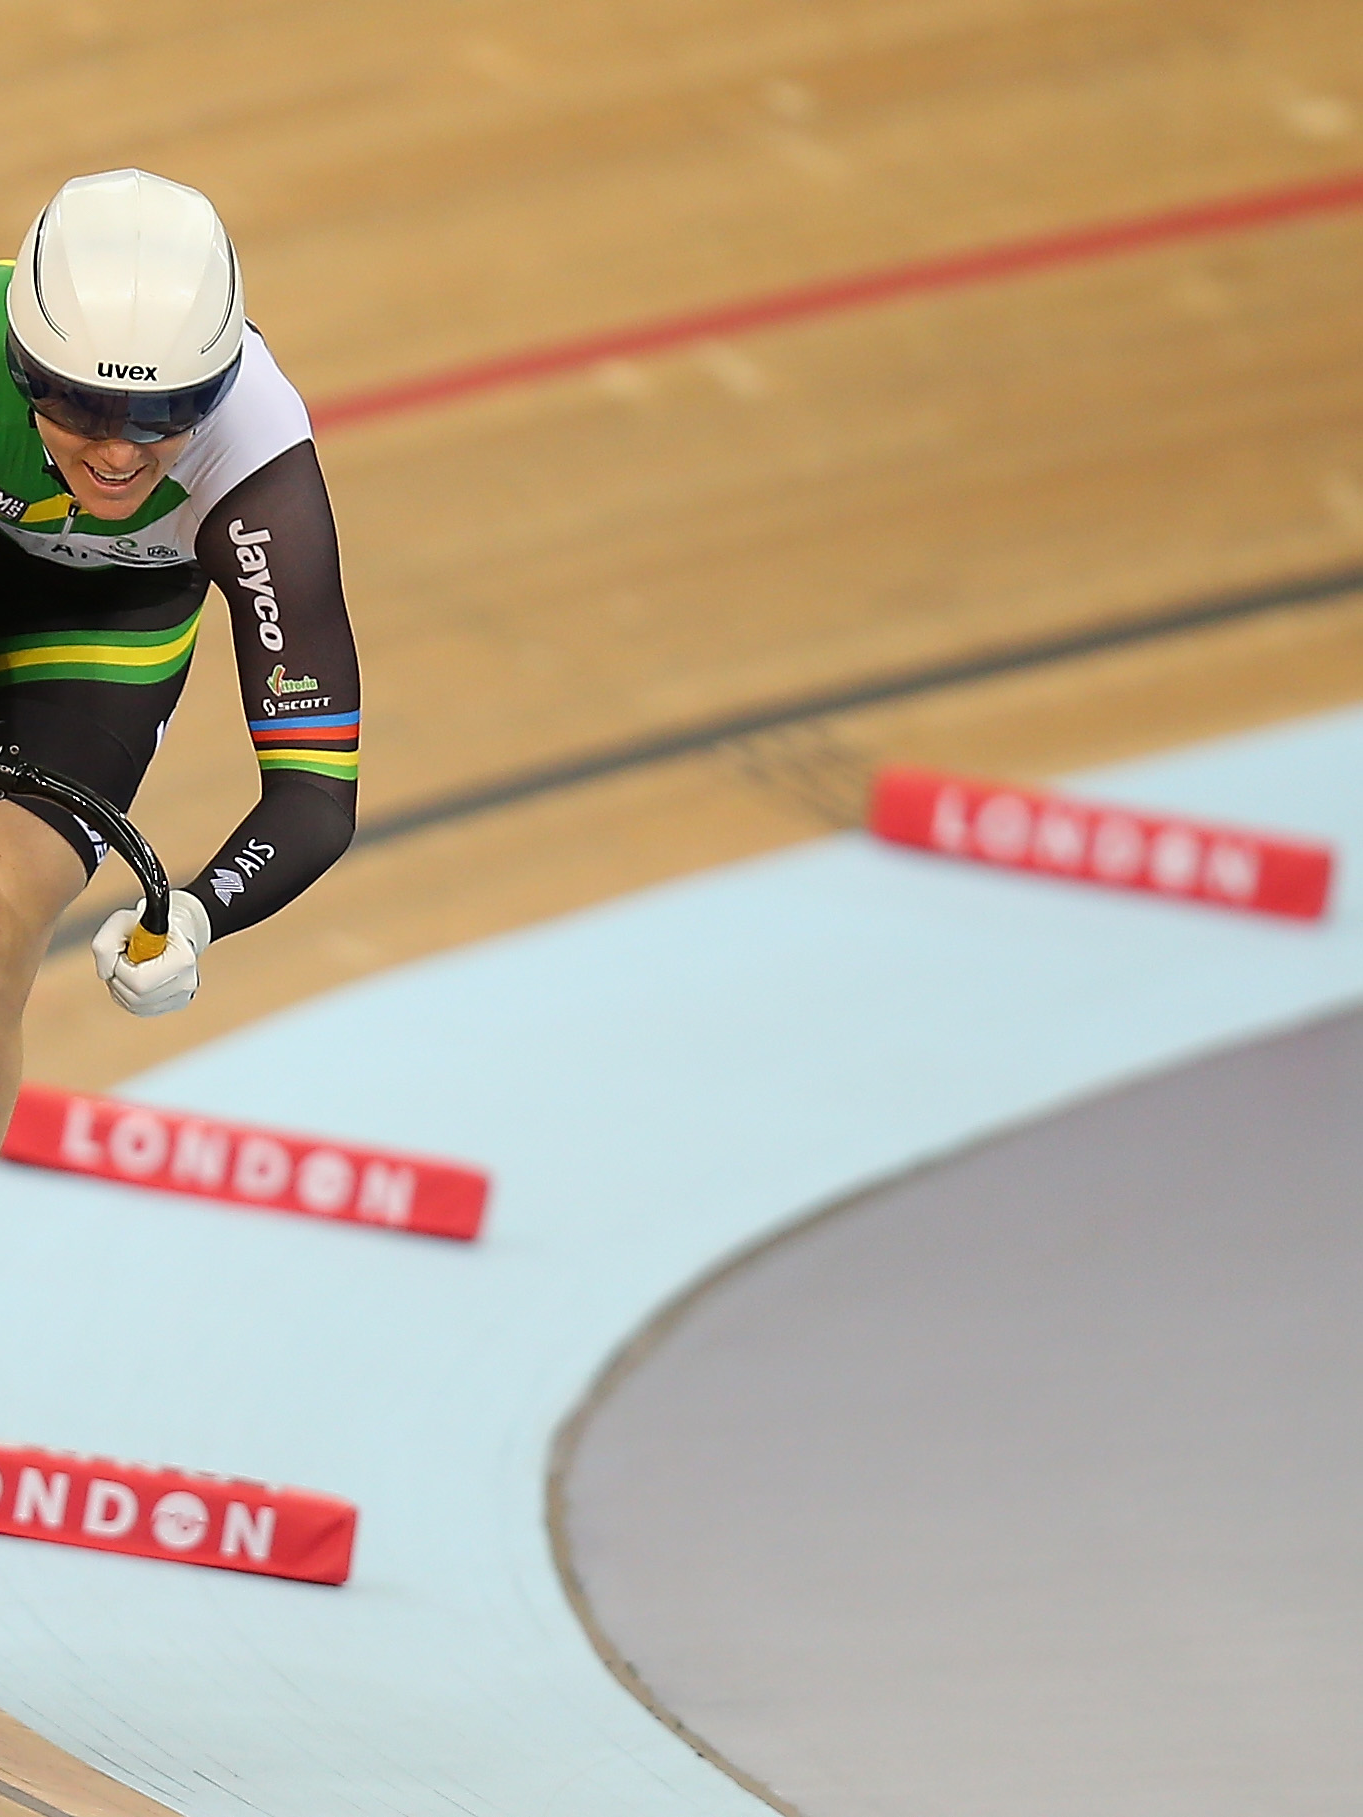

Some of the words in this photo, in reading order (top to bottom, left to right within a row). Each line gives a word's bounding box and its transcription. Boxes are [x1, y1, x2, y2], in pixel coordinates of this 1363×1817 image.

[97, 362, 157, 381] uvex
[228, 519, 284, 652] Jayco
[277, 696, 332, 712] SCOTT
[234, 838, 275, 878] AIS
[59, 1097, 417, 1225] LONDON
